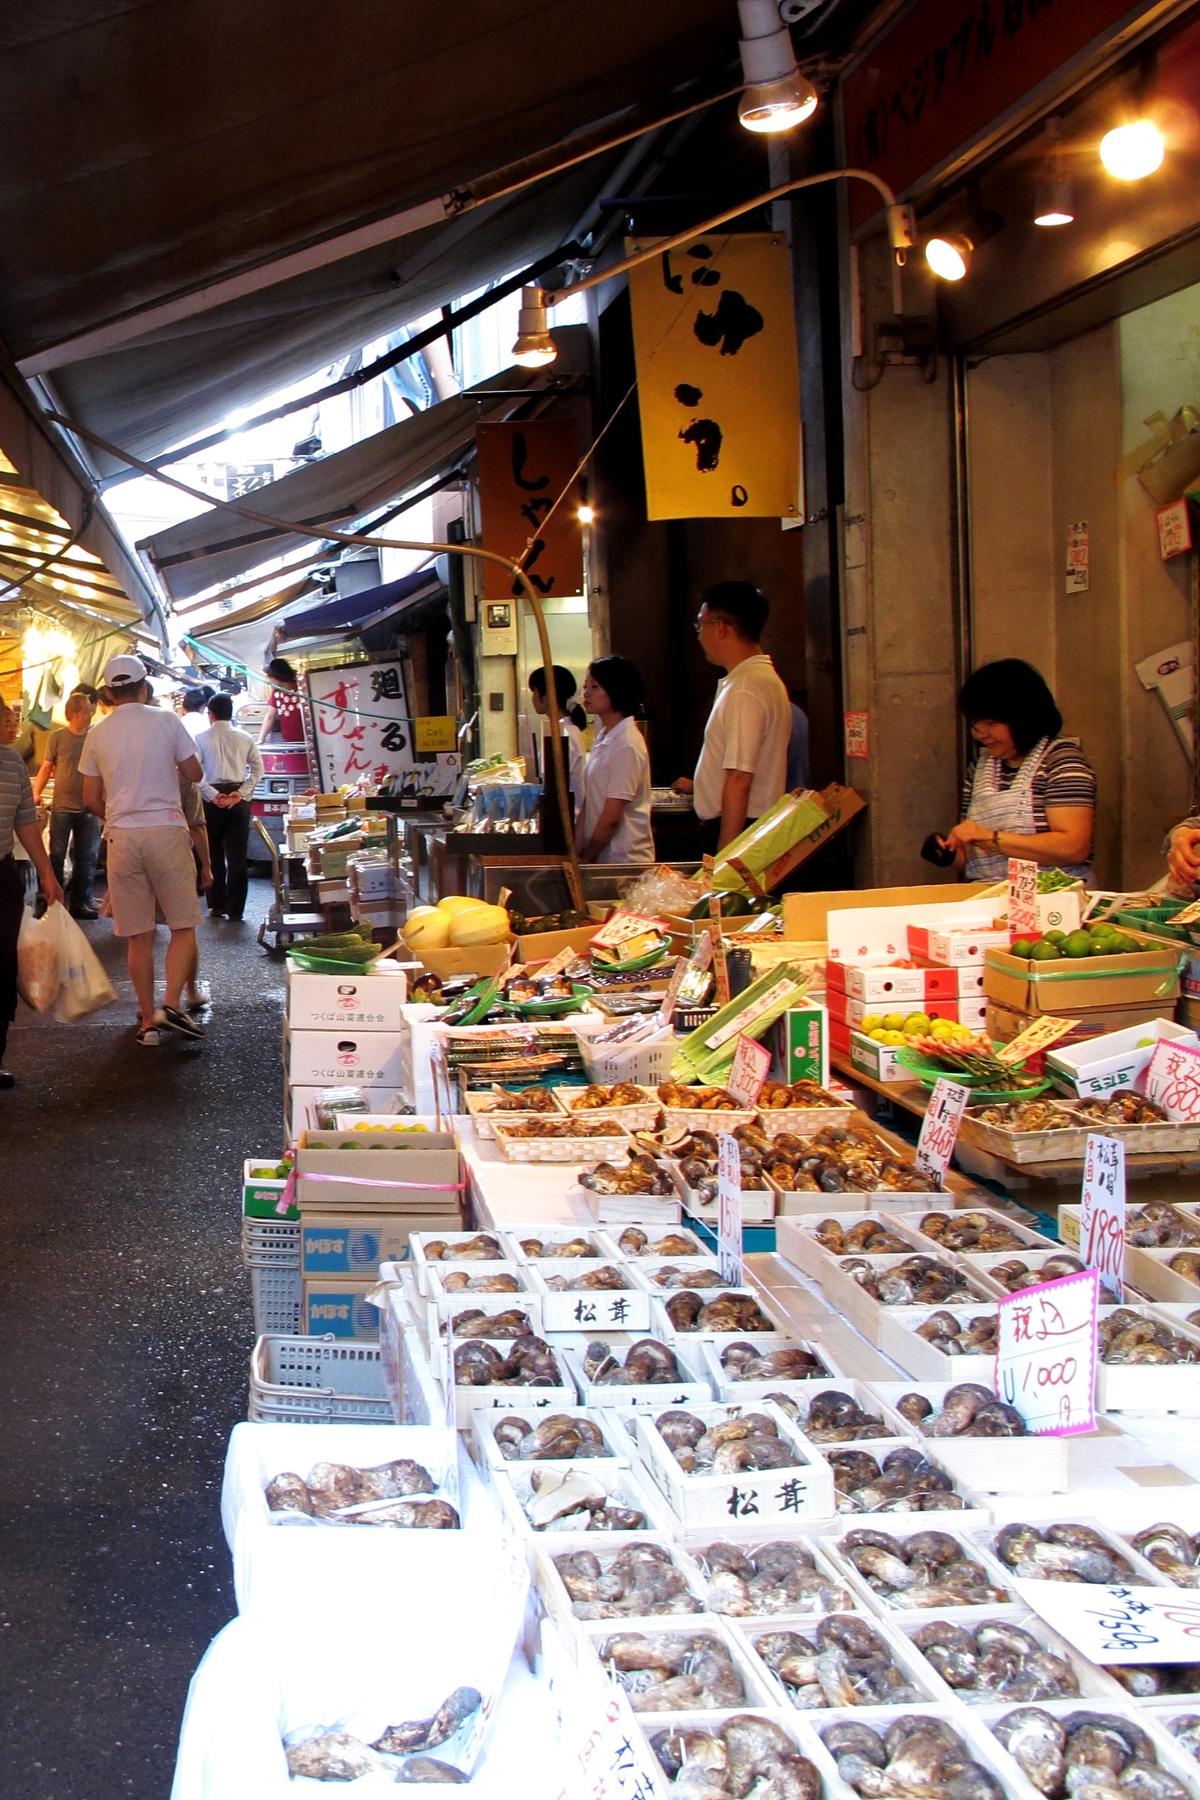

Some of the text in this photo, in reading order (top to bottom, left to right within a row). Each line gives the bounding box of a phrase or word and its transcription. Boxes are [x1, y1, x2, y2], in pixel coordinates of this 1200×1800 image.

[369, 667, 407, 752] 廻る
[305, 1238, 345, 1255] かぼす
[311, 1303, 350, 1320] かぼす
[574, 1298, 632, 1324] 松茸
[1011, 1298, 1091, 1343] 税込
[726, 1478, 807, 1518] 松茸
